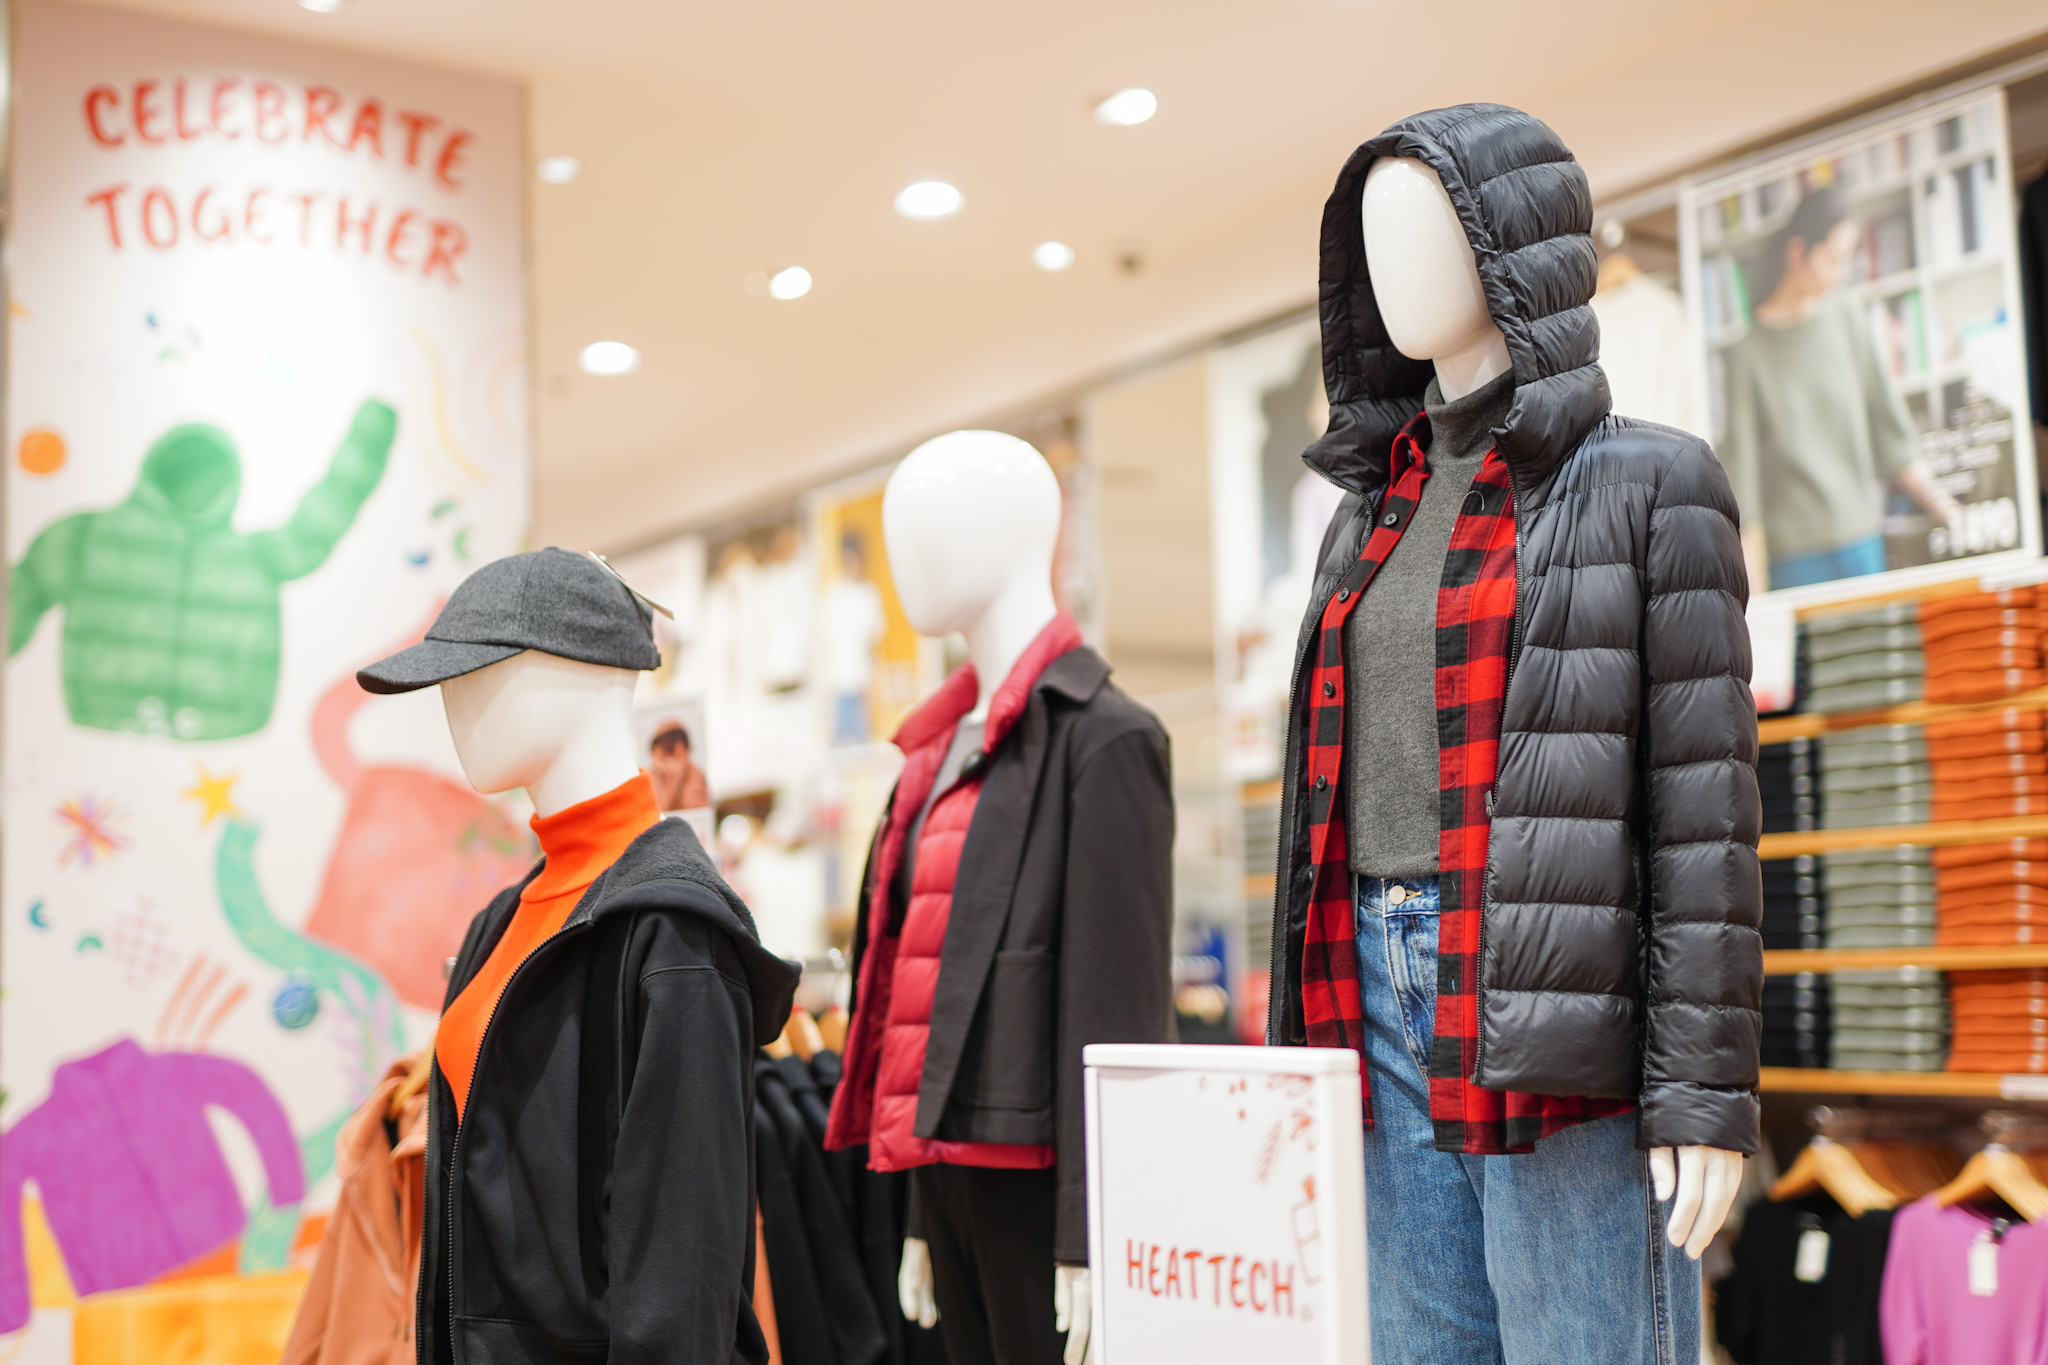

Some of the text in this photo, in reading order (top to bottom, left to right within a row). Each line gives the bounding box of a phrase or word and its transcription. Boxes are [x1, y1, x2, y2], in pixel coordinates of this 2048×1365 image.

[82, 76, 476, 191] CELEBRATE
[85, 182, 471, 287] TOGETHER
[1126, 1238, 1294, 1317] HEATTECH
